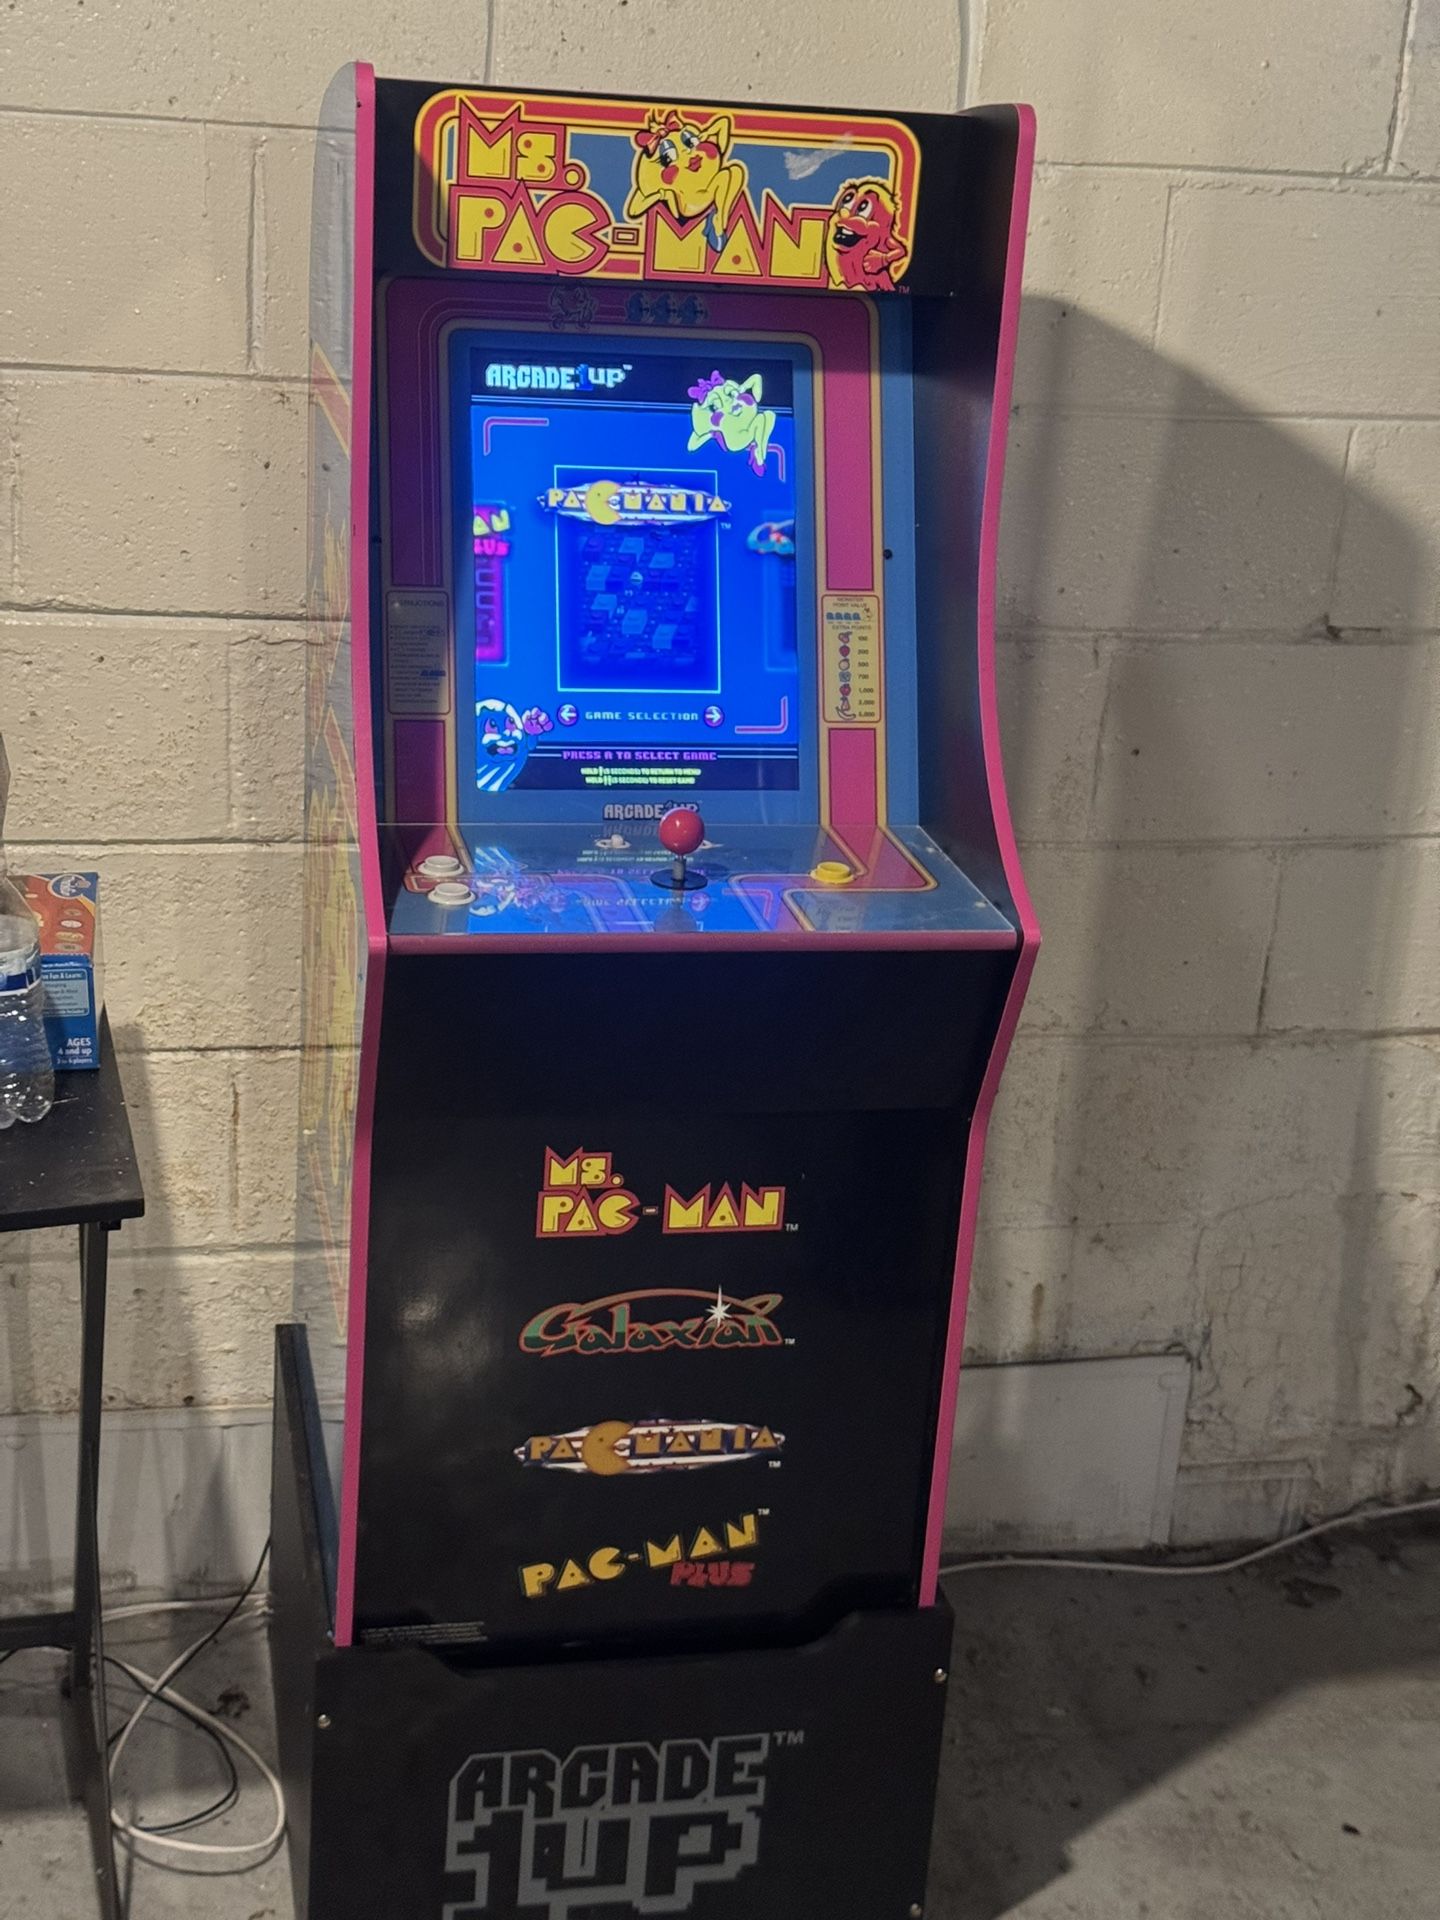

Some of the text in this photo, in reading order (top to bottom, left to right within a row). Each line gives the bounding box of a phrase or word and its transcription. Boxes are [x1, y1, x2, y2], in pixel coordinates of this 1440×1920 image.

[451, 186, 827, 283] PAC-MAN
[585, 711, 699, 721] GAME SELECTION
[562, 750, 601, 760] PRESS
[616, 751, 632, 760] TO
[635, 751, 680, 760] SELECT
[683, 752, 717, 761] GAME
[67, 1037, 91, 1046] AGES
[81, 1048, 92, 1056] up
[537, 1184, 784, 1236] PAC-MAN
[519, 1288, 783, 1356] Galaxian
[520, 1513, 758, 1598] PAC-MAN
[670, 1561, 755, 1587] PLUS
[450, 1730, 805, 1822] ARCADE TM
